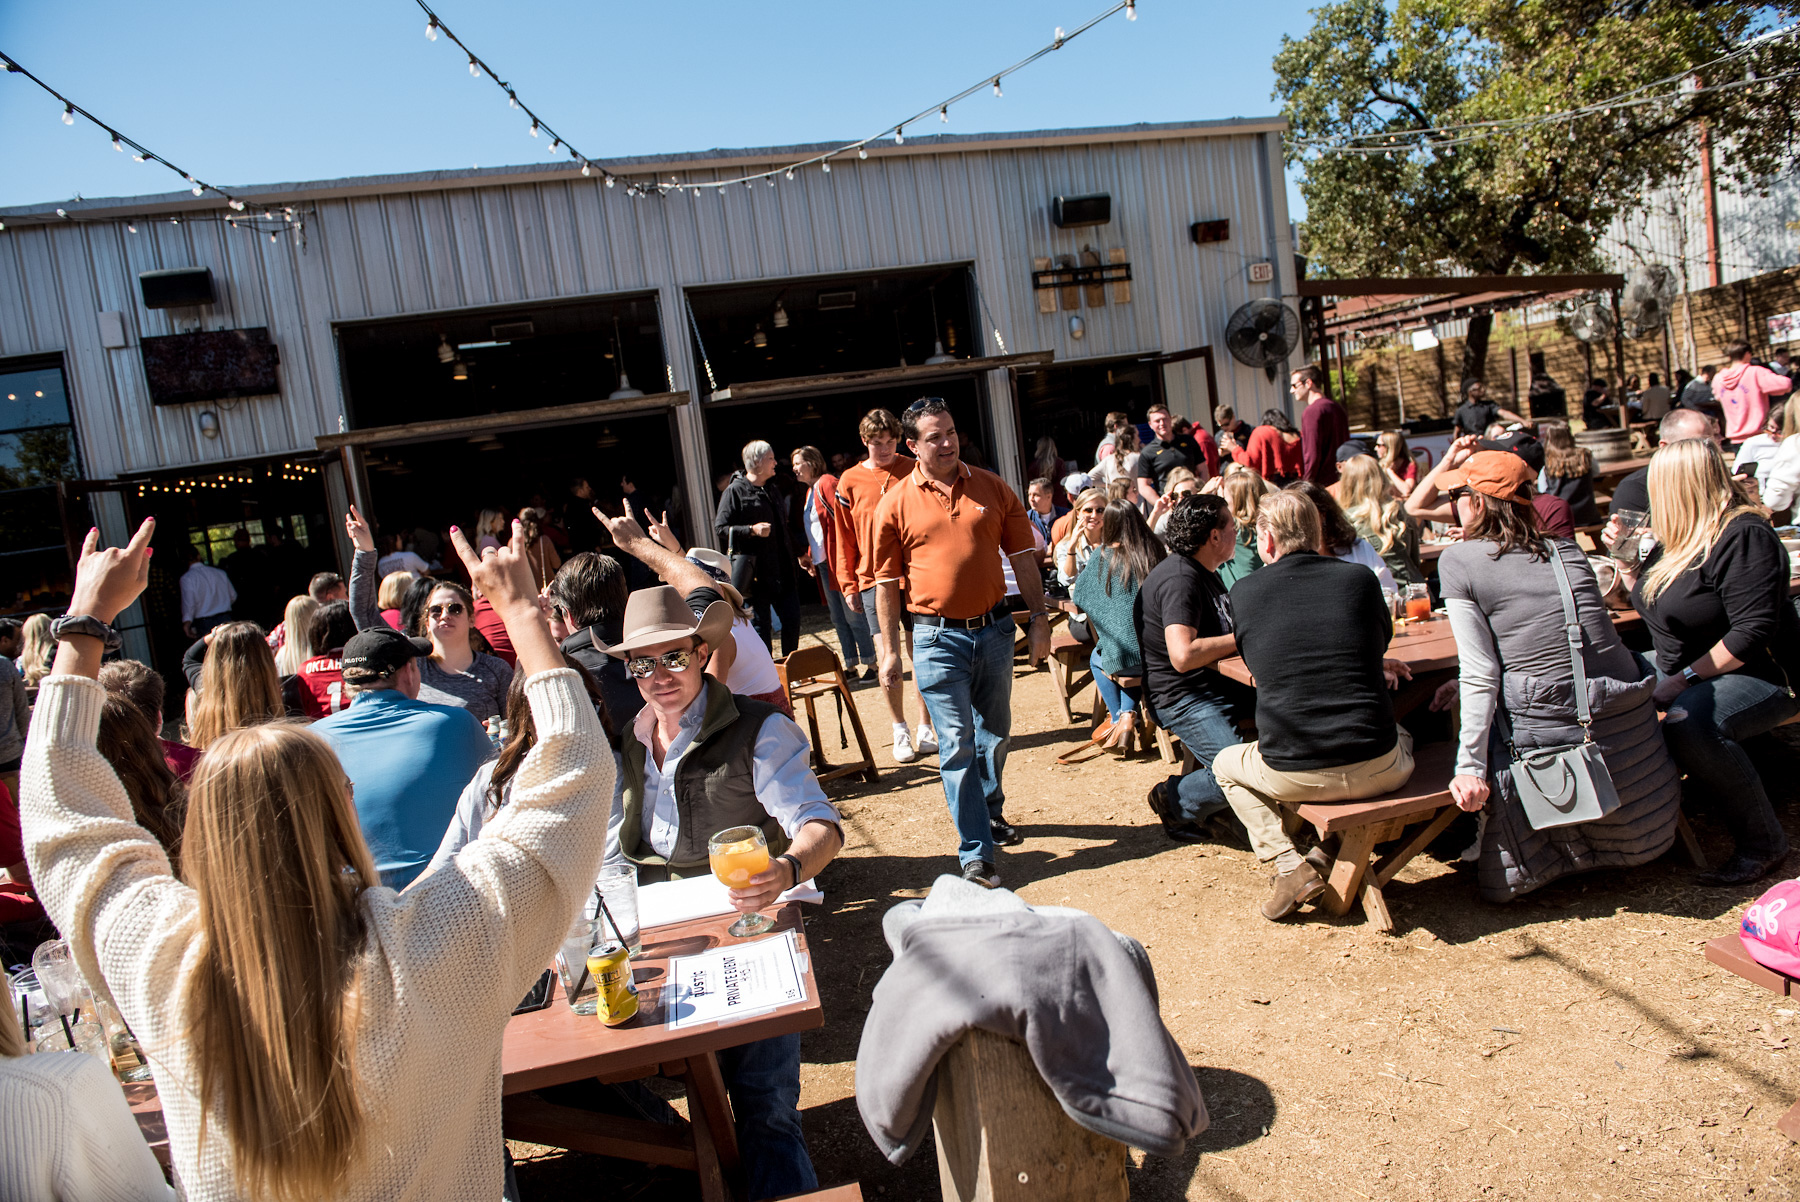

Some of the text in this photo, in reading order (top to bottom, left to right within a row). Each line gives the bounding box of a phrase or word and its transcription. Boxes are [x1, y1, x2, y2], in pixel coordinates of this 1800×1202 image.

[1253, 265, 1269, 279] EXIT
[723, 955, 741, 1007] PRIVATE EVENT
